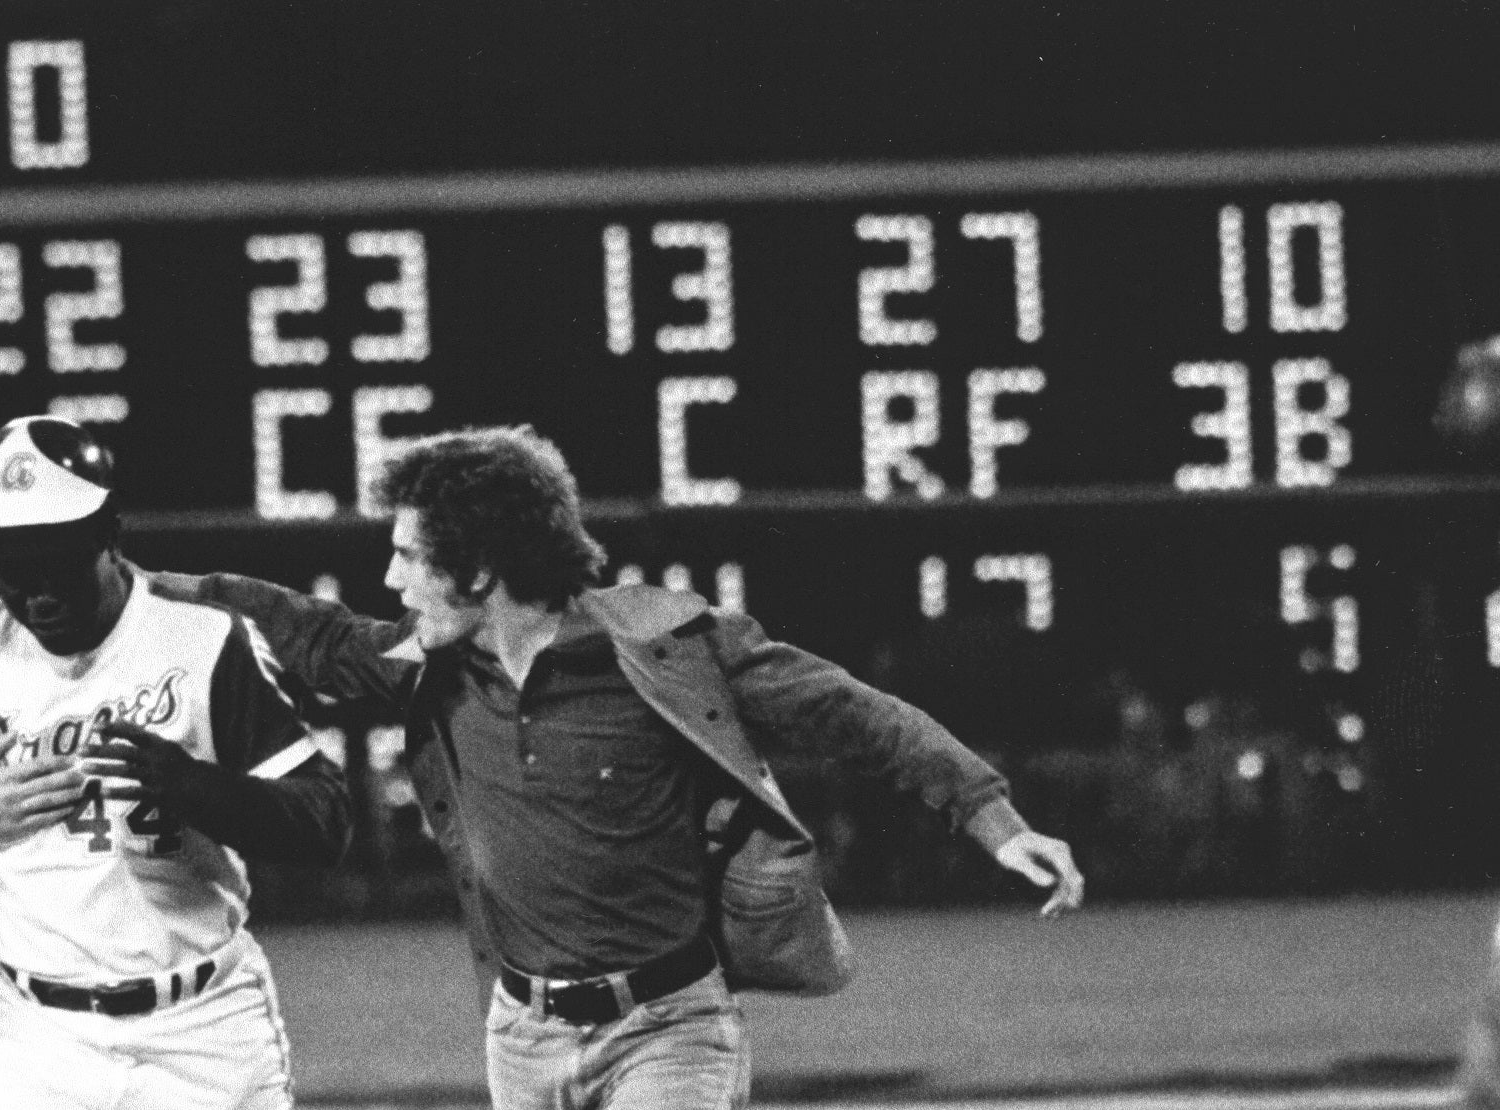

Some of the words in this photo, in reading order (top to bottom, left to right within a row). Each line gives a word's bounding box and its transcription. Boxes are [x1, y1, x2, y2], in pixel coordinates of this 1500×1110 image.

[247, 230, 430, 367] 23
[603, 222, 734, 355] 13
[855, 212, 1043, 346] 27
[1219, 202, 1346, 333] 10
[658, 377, 741, 507] C
[861, 368, 1046, 503] RF
[1173, 357, 1351, 493] 3B
[64, 778, 184, 854] 44
